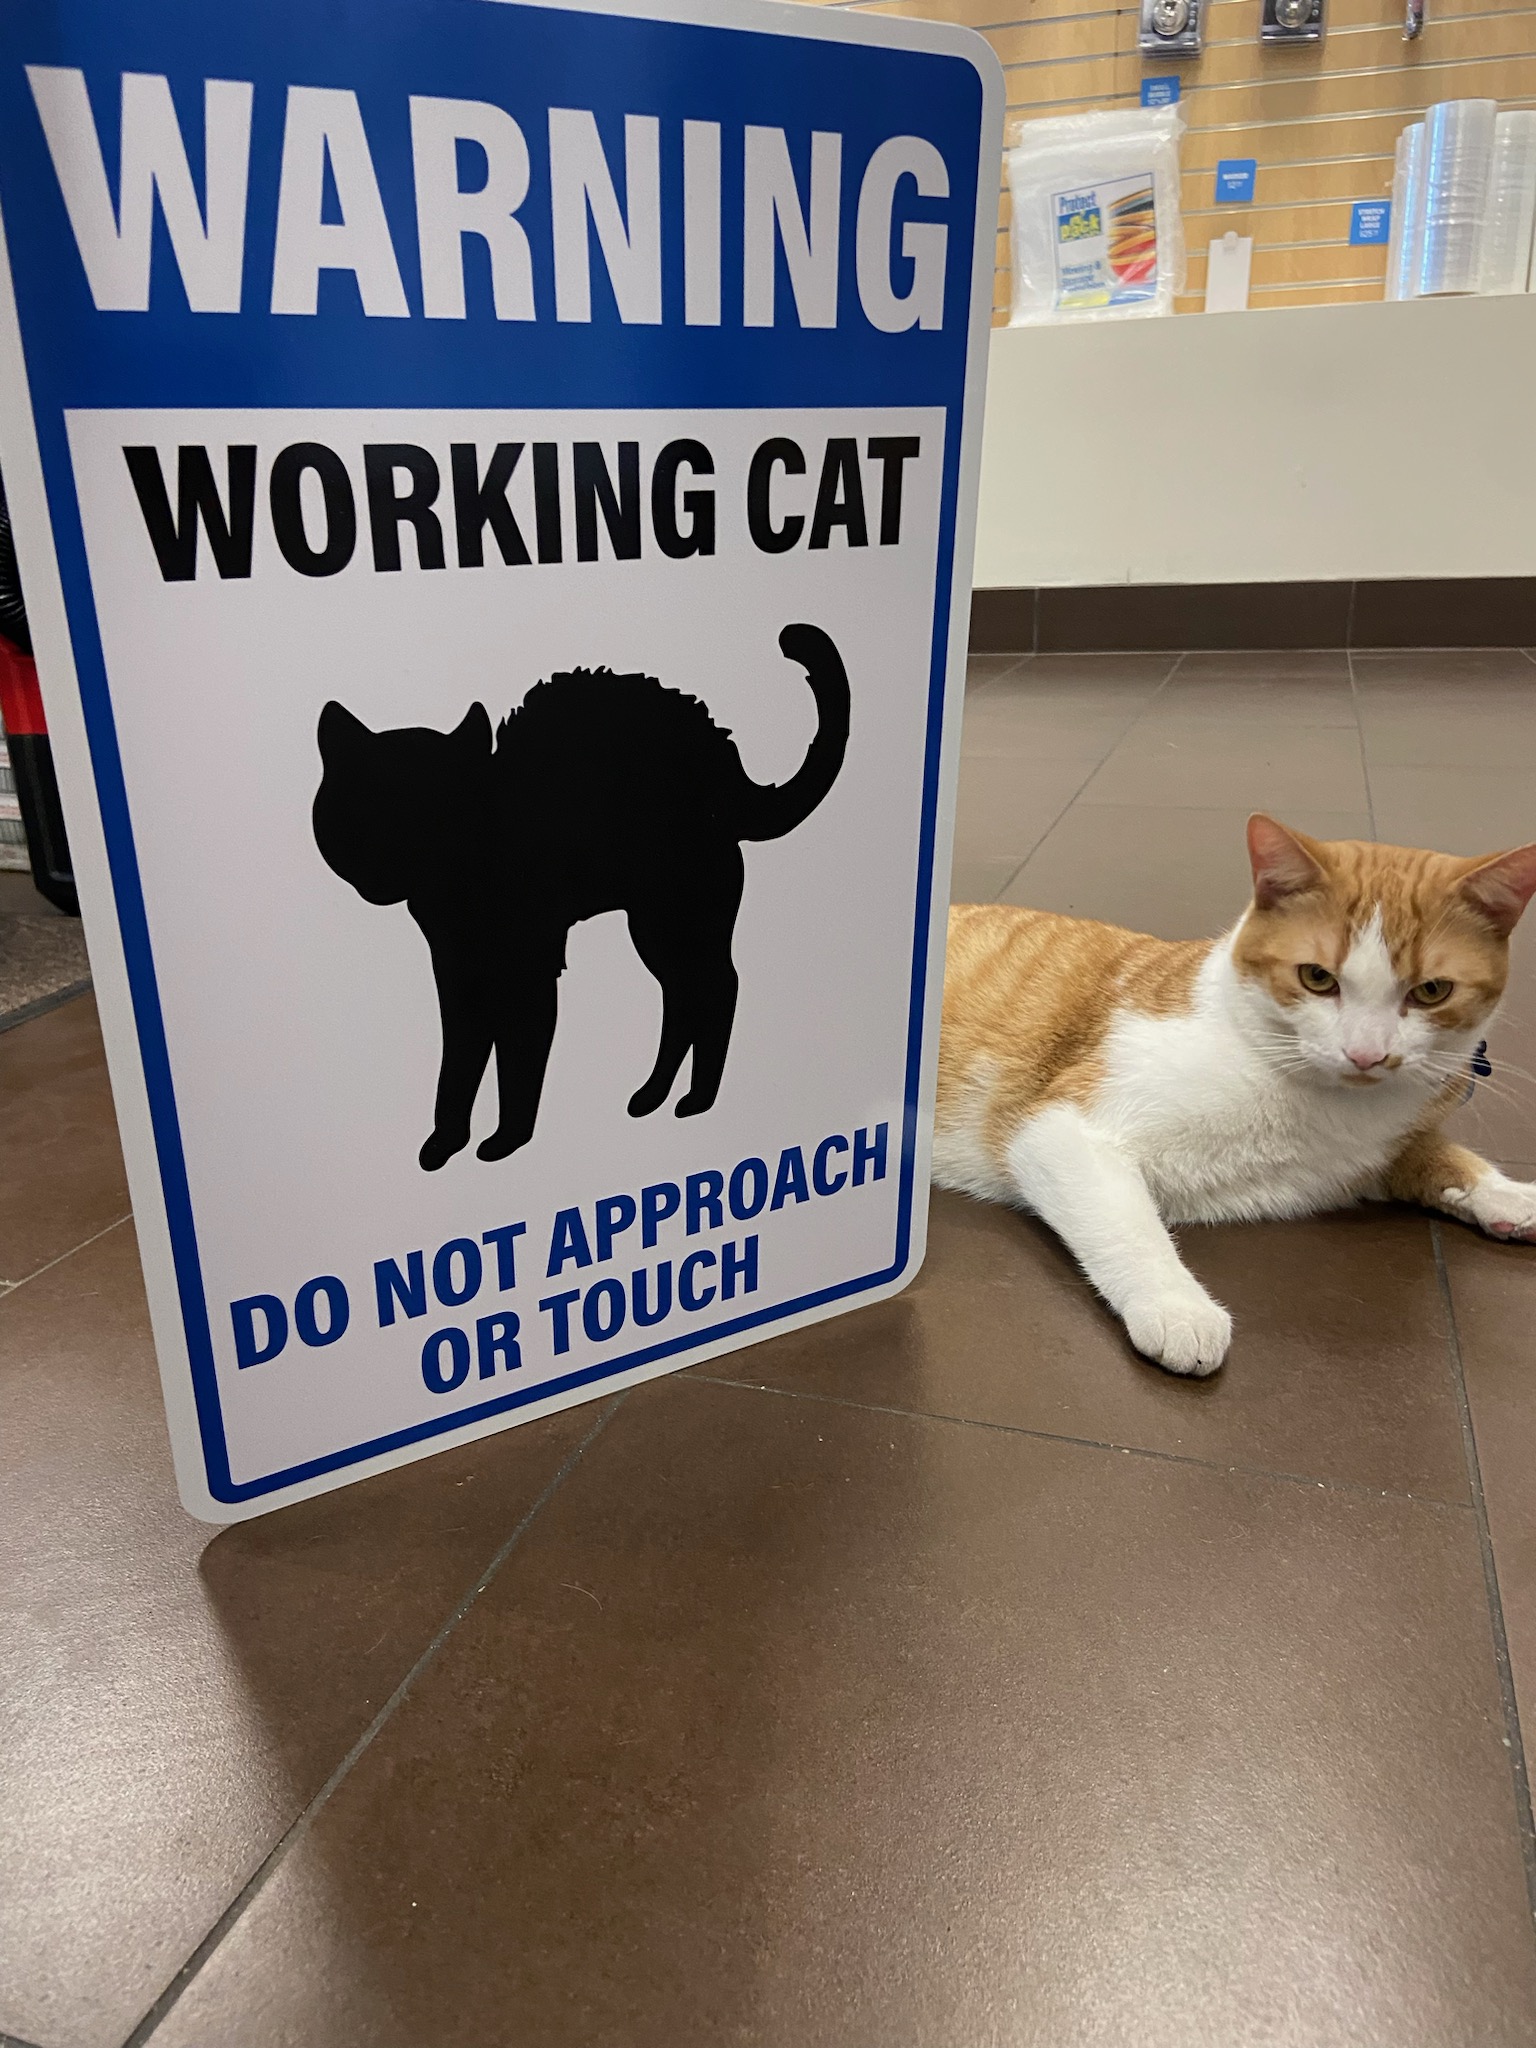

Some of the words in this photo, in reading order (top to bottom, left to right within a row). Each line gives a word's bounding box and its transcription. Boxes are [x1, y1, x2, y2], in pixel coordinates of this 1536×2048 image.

[25, 65, 950, 333] WARNING
[122, 439, 715, 582] WORKING
[747, 437, 920, 553] CAT
[231, 1276, 349, 1369] DO
[374, 1222, 526, 1327] NOT
[547, 1123, 888, 1277] APPROACH
[422, 1312, 521, 1393] OR
[539, 1235, 758, 1355] TOUCH
